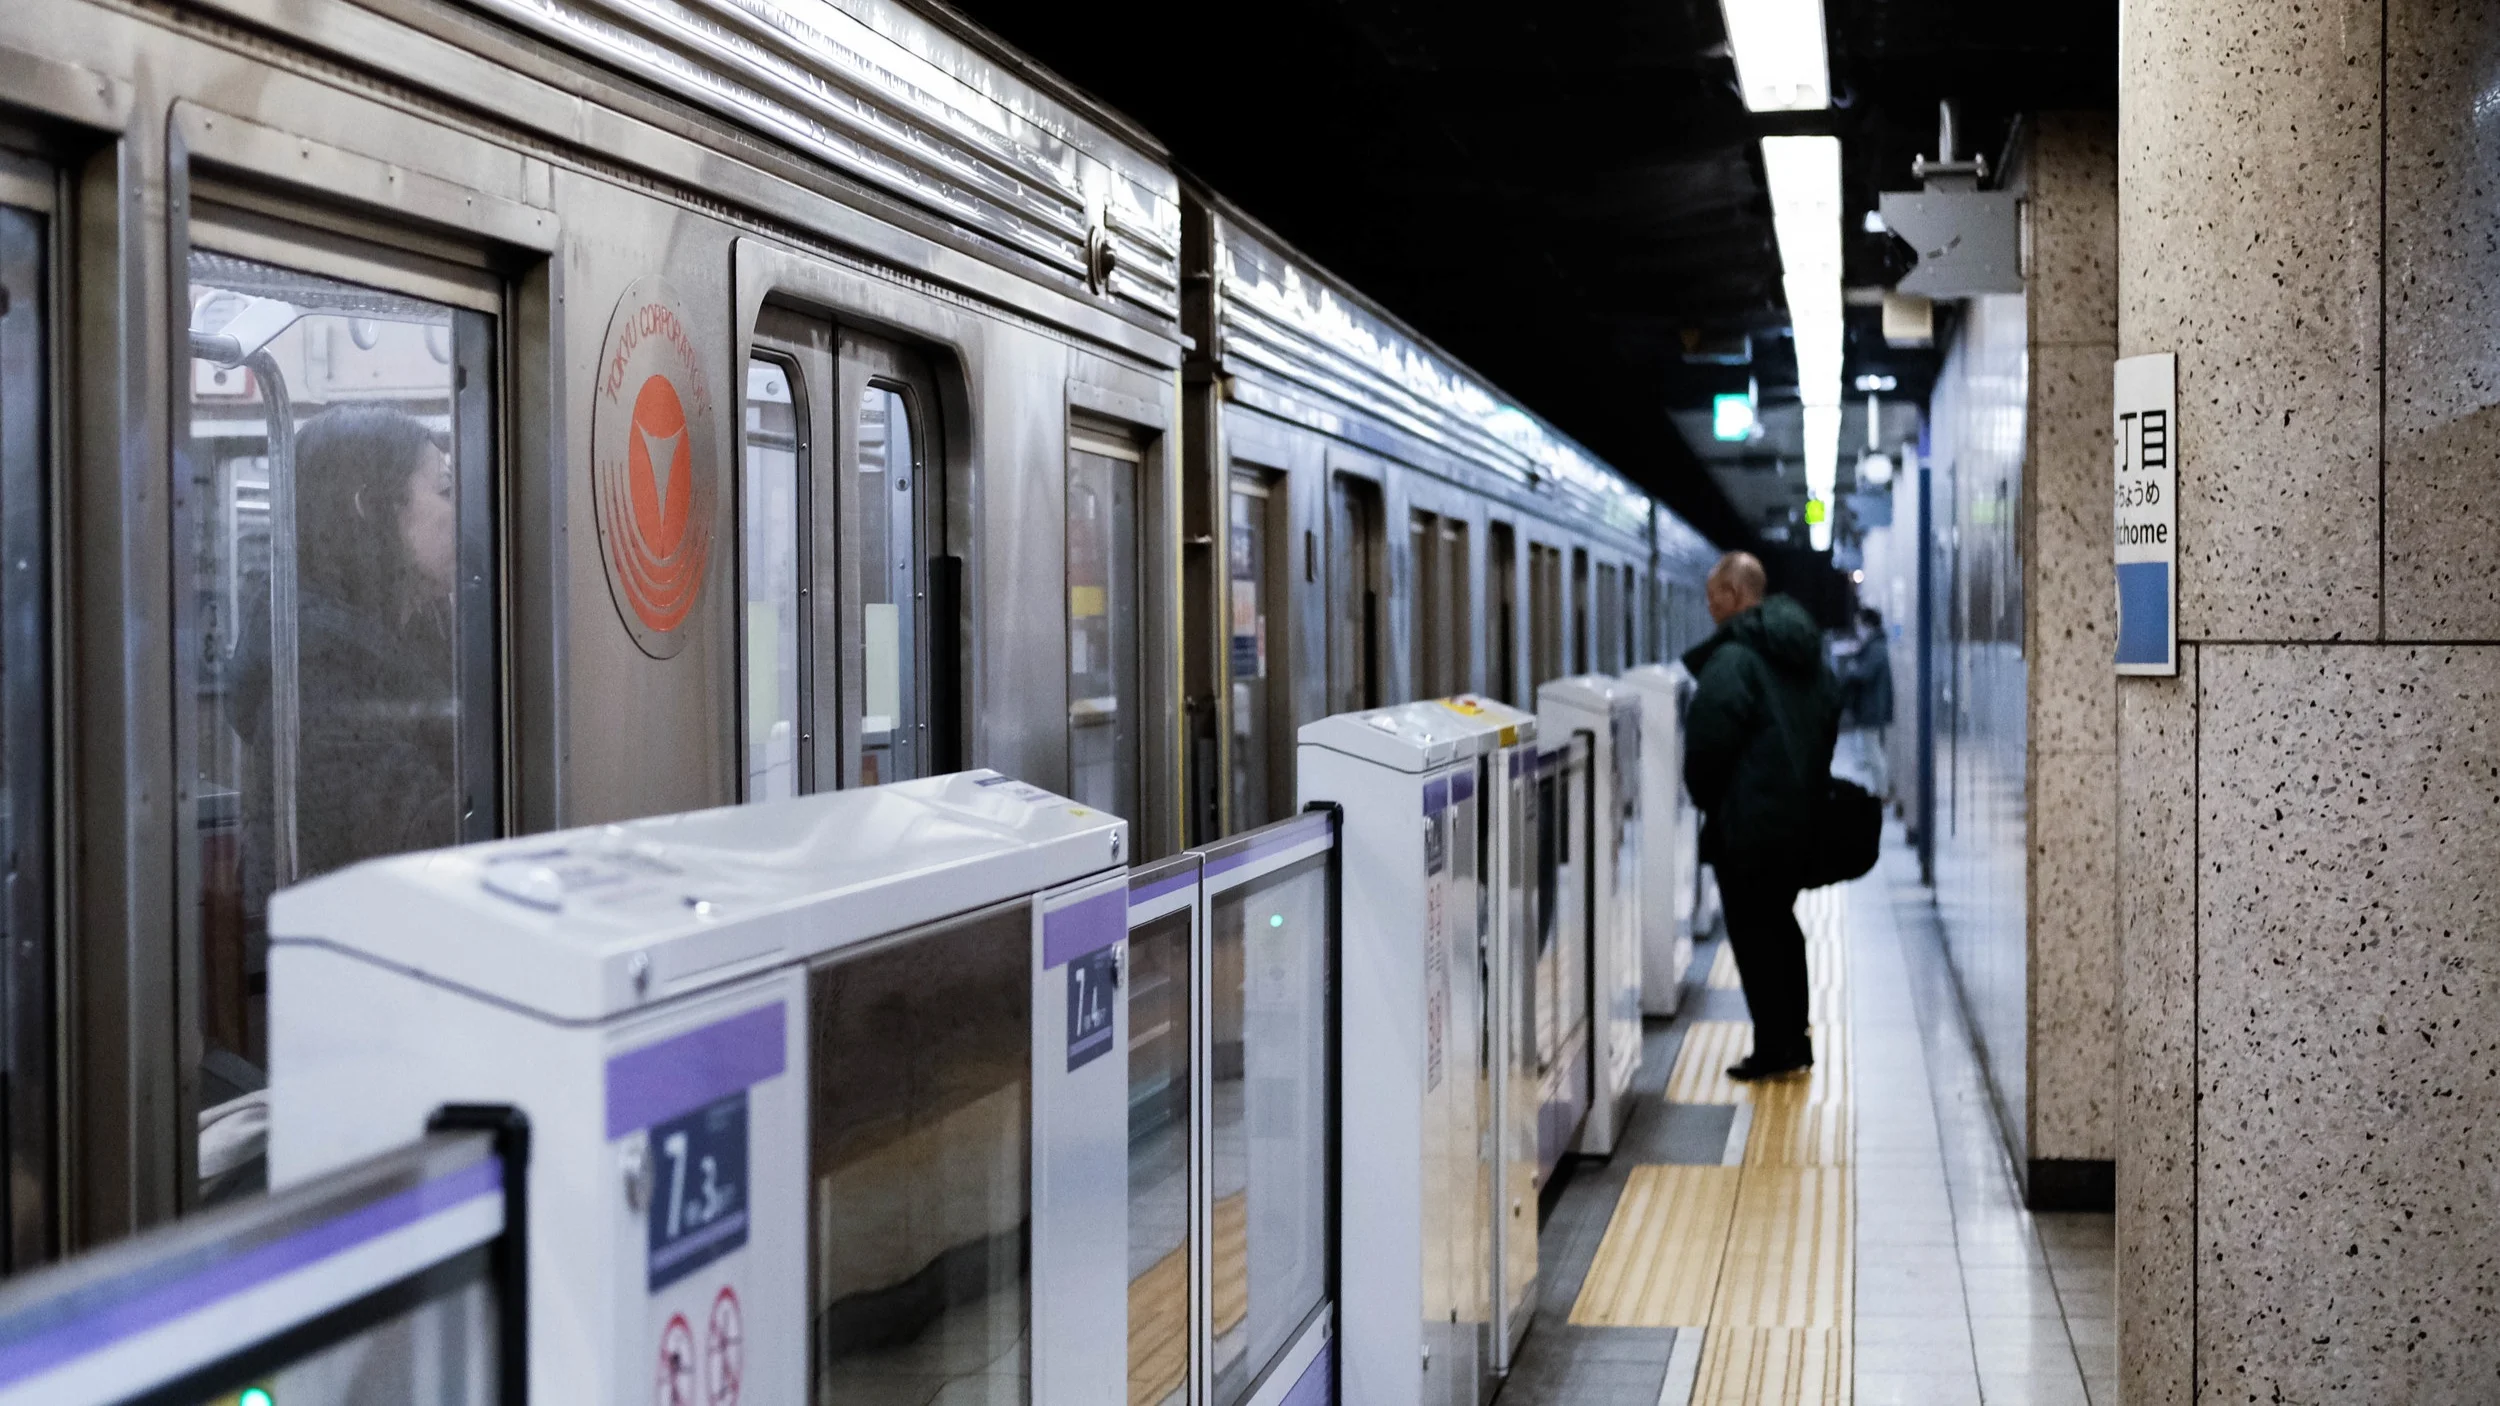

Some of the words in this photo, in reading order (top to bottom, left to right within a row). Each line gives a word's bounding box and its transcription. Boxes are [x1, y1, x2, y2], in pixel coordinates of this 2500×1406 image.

[606, 314, 637, 405] TOKYU
[639, 303, 706, 416] CORPORATION
[2114, 409, 2167, 472] 丁目
[2115, 479, 2160, 507] ちょうめ
